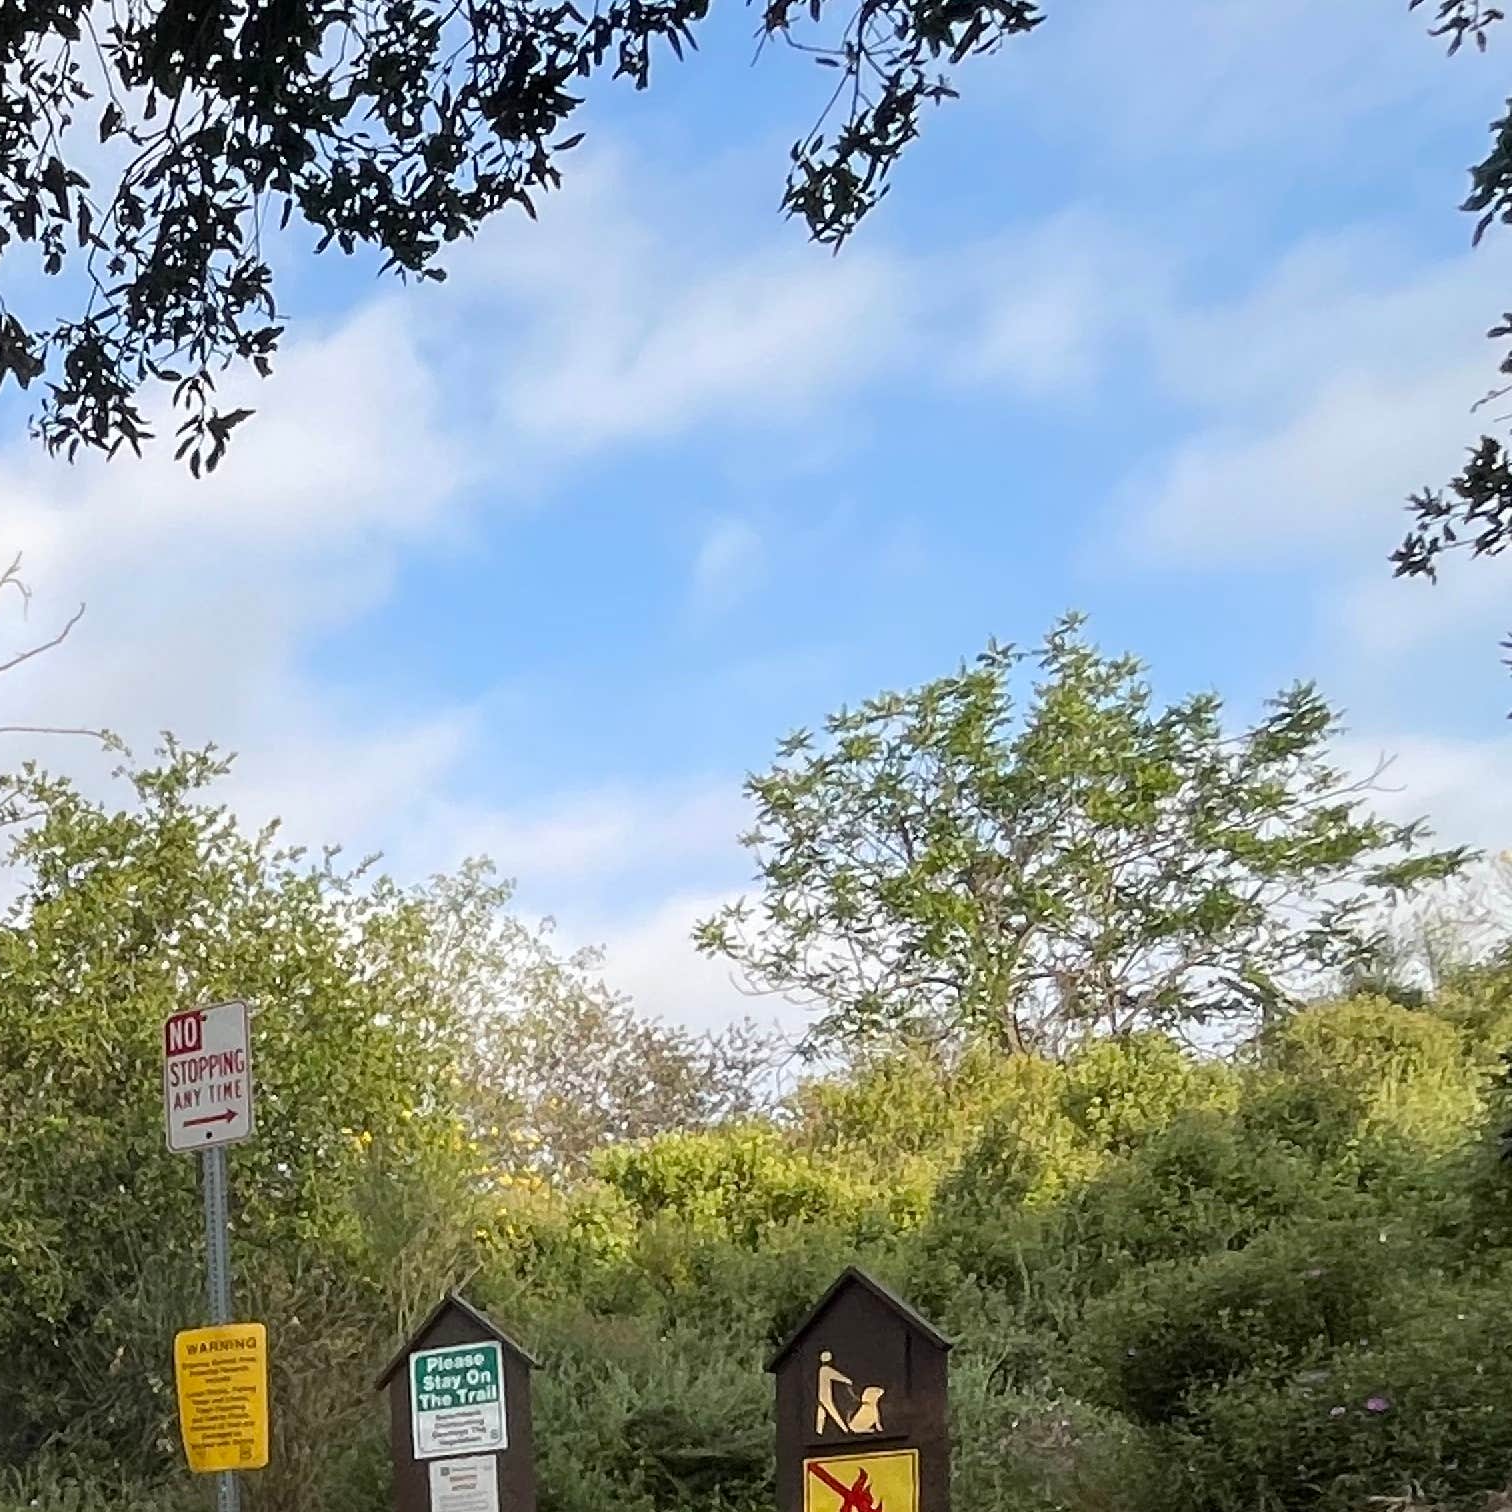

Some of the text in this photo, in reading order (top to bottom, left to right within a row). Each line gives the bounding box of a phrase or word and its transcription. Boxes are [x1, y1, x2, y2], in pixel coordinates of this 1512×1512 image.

[169, 1016, 198, 1052] NO
[169, 1048, 245, 1088] STOPPING
[173, 1079, 243, 1111] ANY TIME
[186, 1336, 257, 1355] WARNING
[427, 1353, 485, 1374] Please
[423, 1368, 491, 1392] Stay On
[419, 1384, 497, 1410] The Trail
